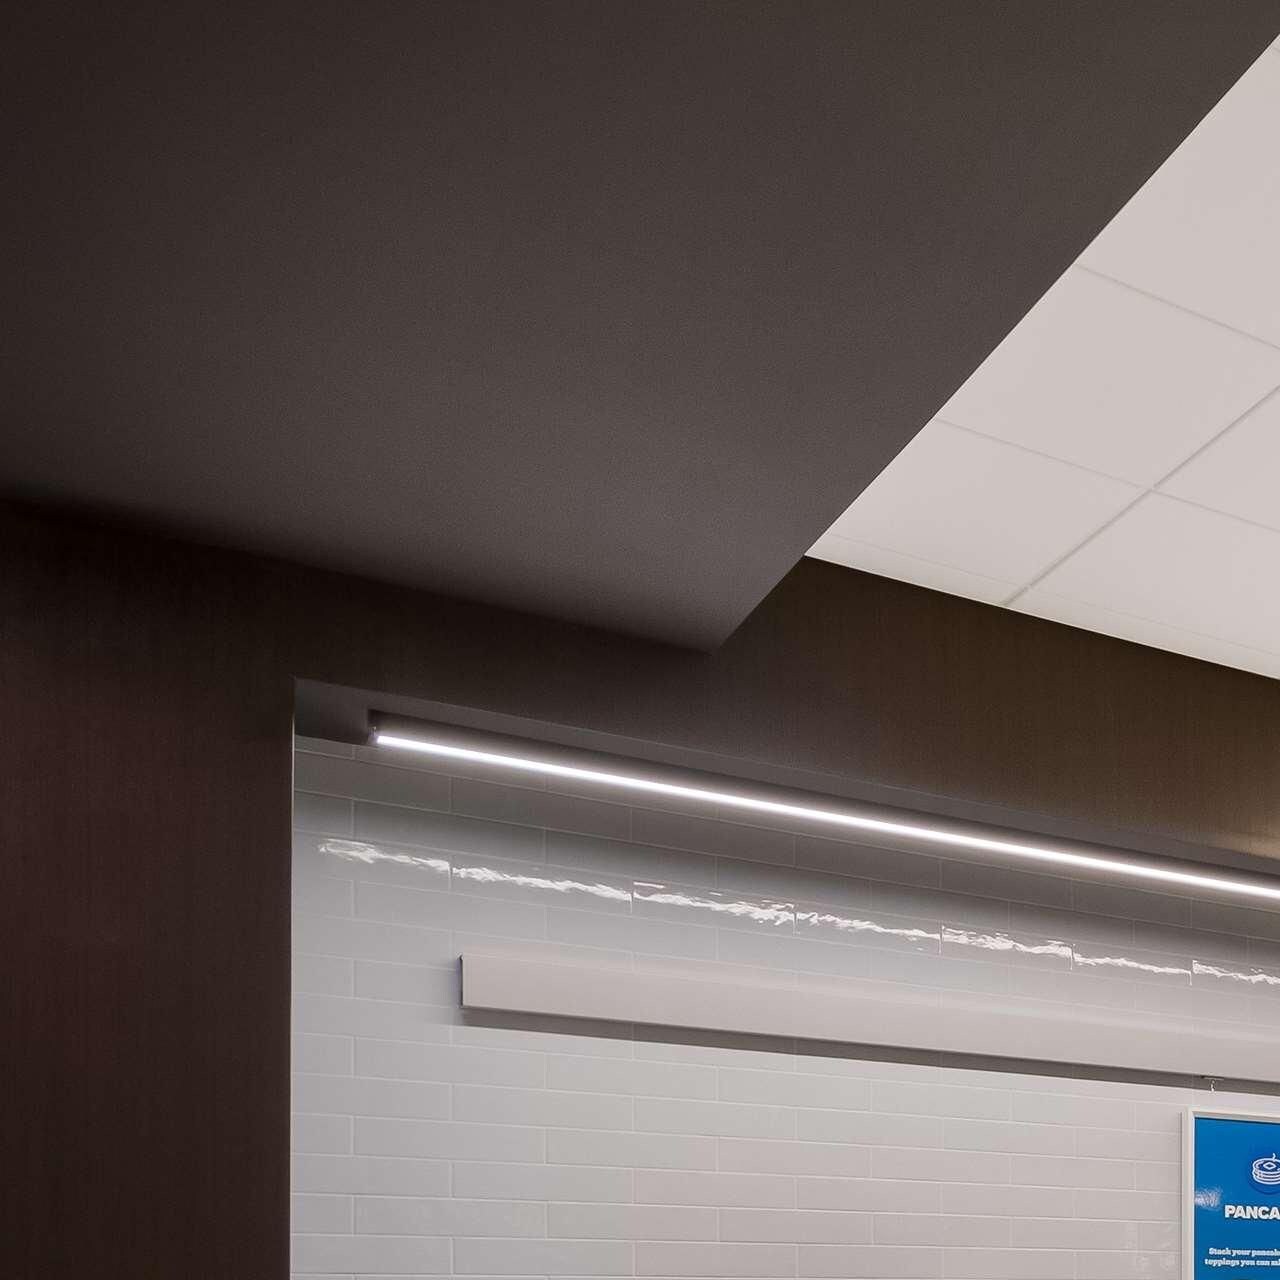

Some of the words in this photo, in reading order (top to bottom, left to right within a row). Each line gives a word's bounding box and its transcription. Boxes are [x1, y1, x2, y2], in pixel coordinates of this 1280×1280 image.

[1209, 1247, 1231, 1256] Stack
[1231, 1249, 1251, 1257] your
[1205, 1257, 1240, 1267] toppings
[1240, 1259, 1255, 1267] you
